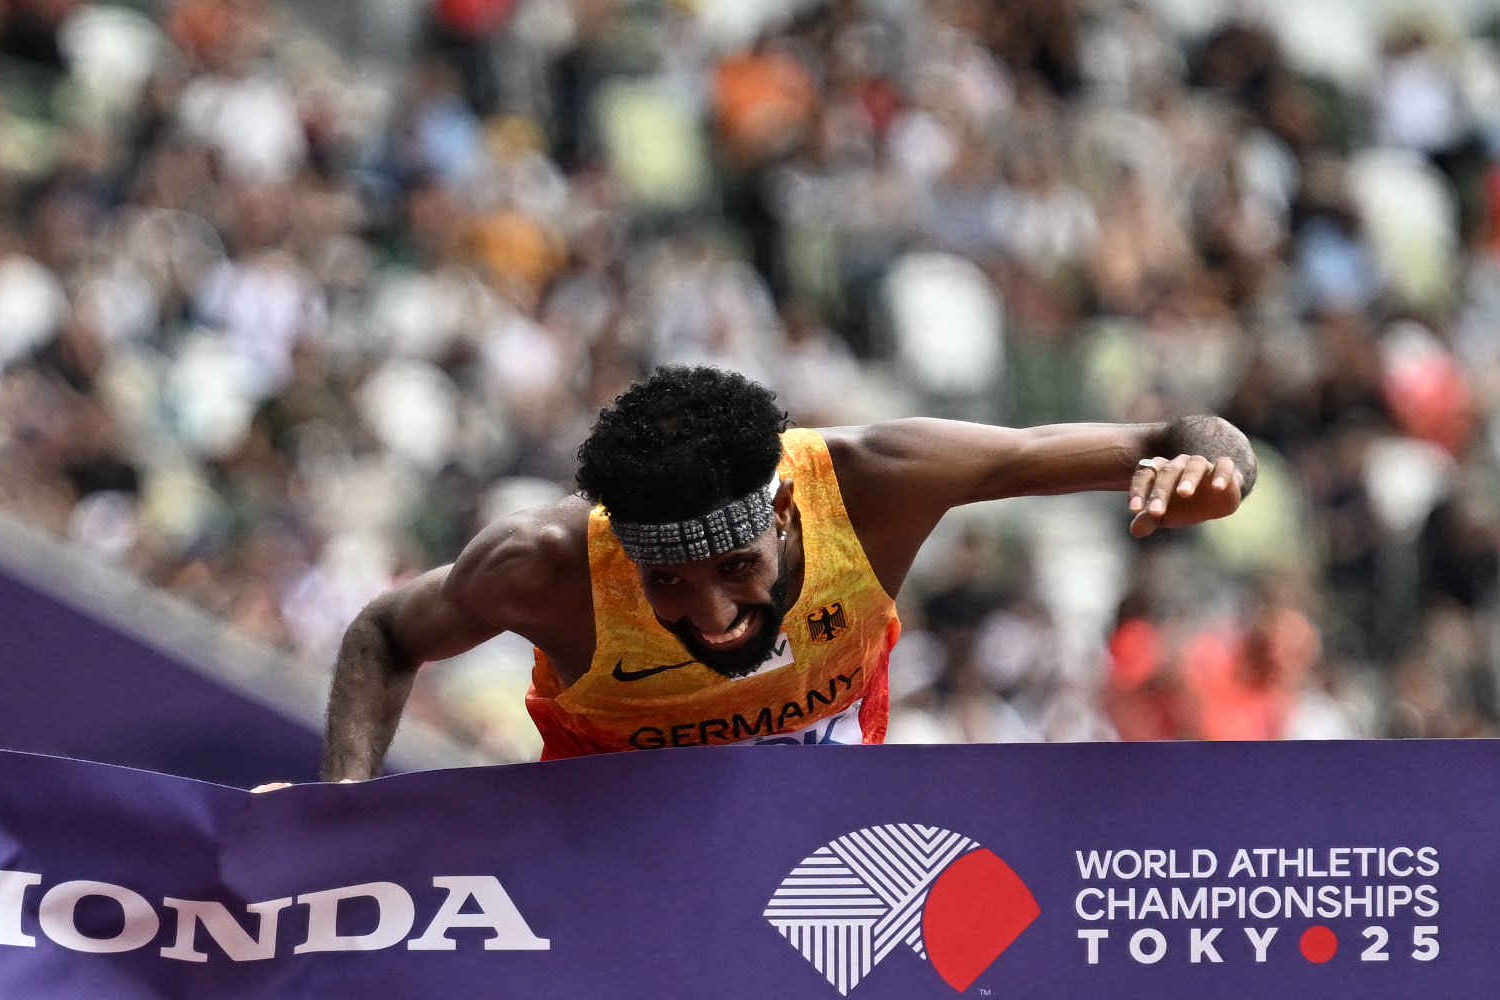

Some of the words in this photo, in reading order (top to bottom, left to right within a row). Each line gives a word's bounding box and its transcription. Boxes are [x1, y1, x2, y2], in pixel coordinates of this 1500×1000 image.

[629, 667, 862, 750] GERMANY
[1075, 849, 1217, 879] WORLD
[1228, 846, 1440, 878] ATHLETICS
[1075, 884, 1440, 921] CHAMPIONSHIPS
[1361, 925, 1440, 961] 25
